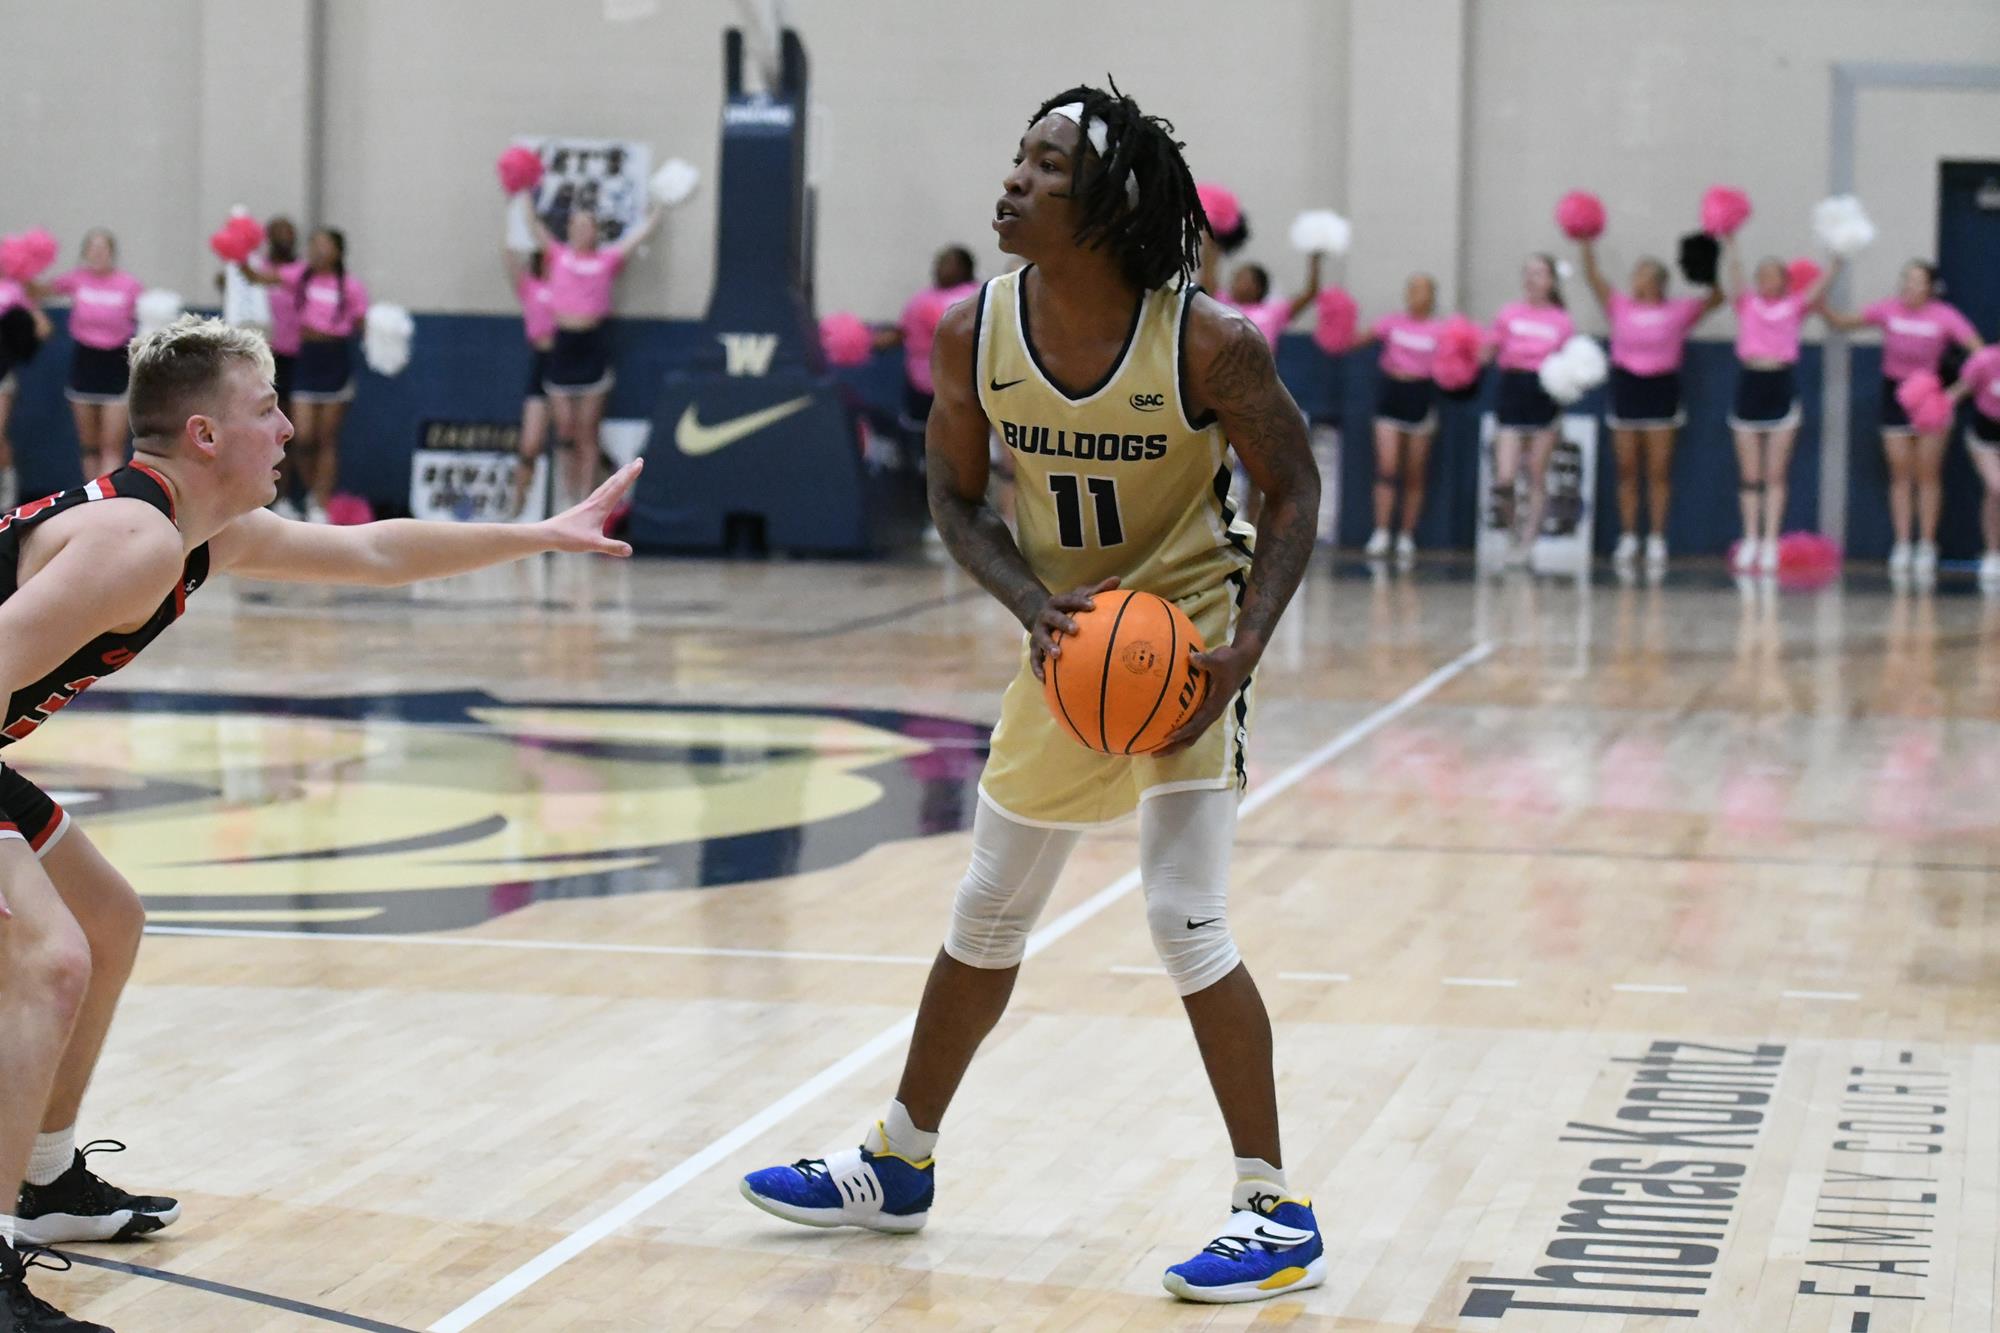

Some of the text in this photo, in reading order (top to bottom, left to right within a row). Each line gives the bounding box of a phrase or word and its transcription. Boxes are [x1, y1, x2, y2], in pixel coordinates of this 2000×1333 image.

[717, 332, 779, 377] W
[1133, 393, 1165, 407] SAC
[1000, 420, 1168, 462] BULLDOGS
[1048, 473, 1125, 549] 11
[1458, 1041, 1787, 1318] Thomas Koontz
[1797, 1065, 1951, 1301] FAMILY COURT
